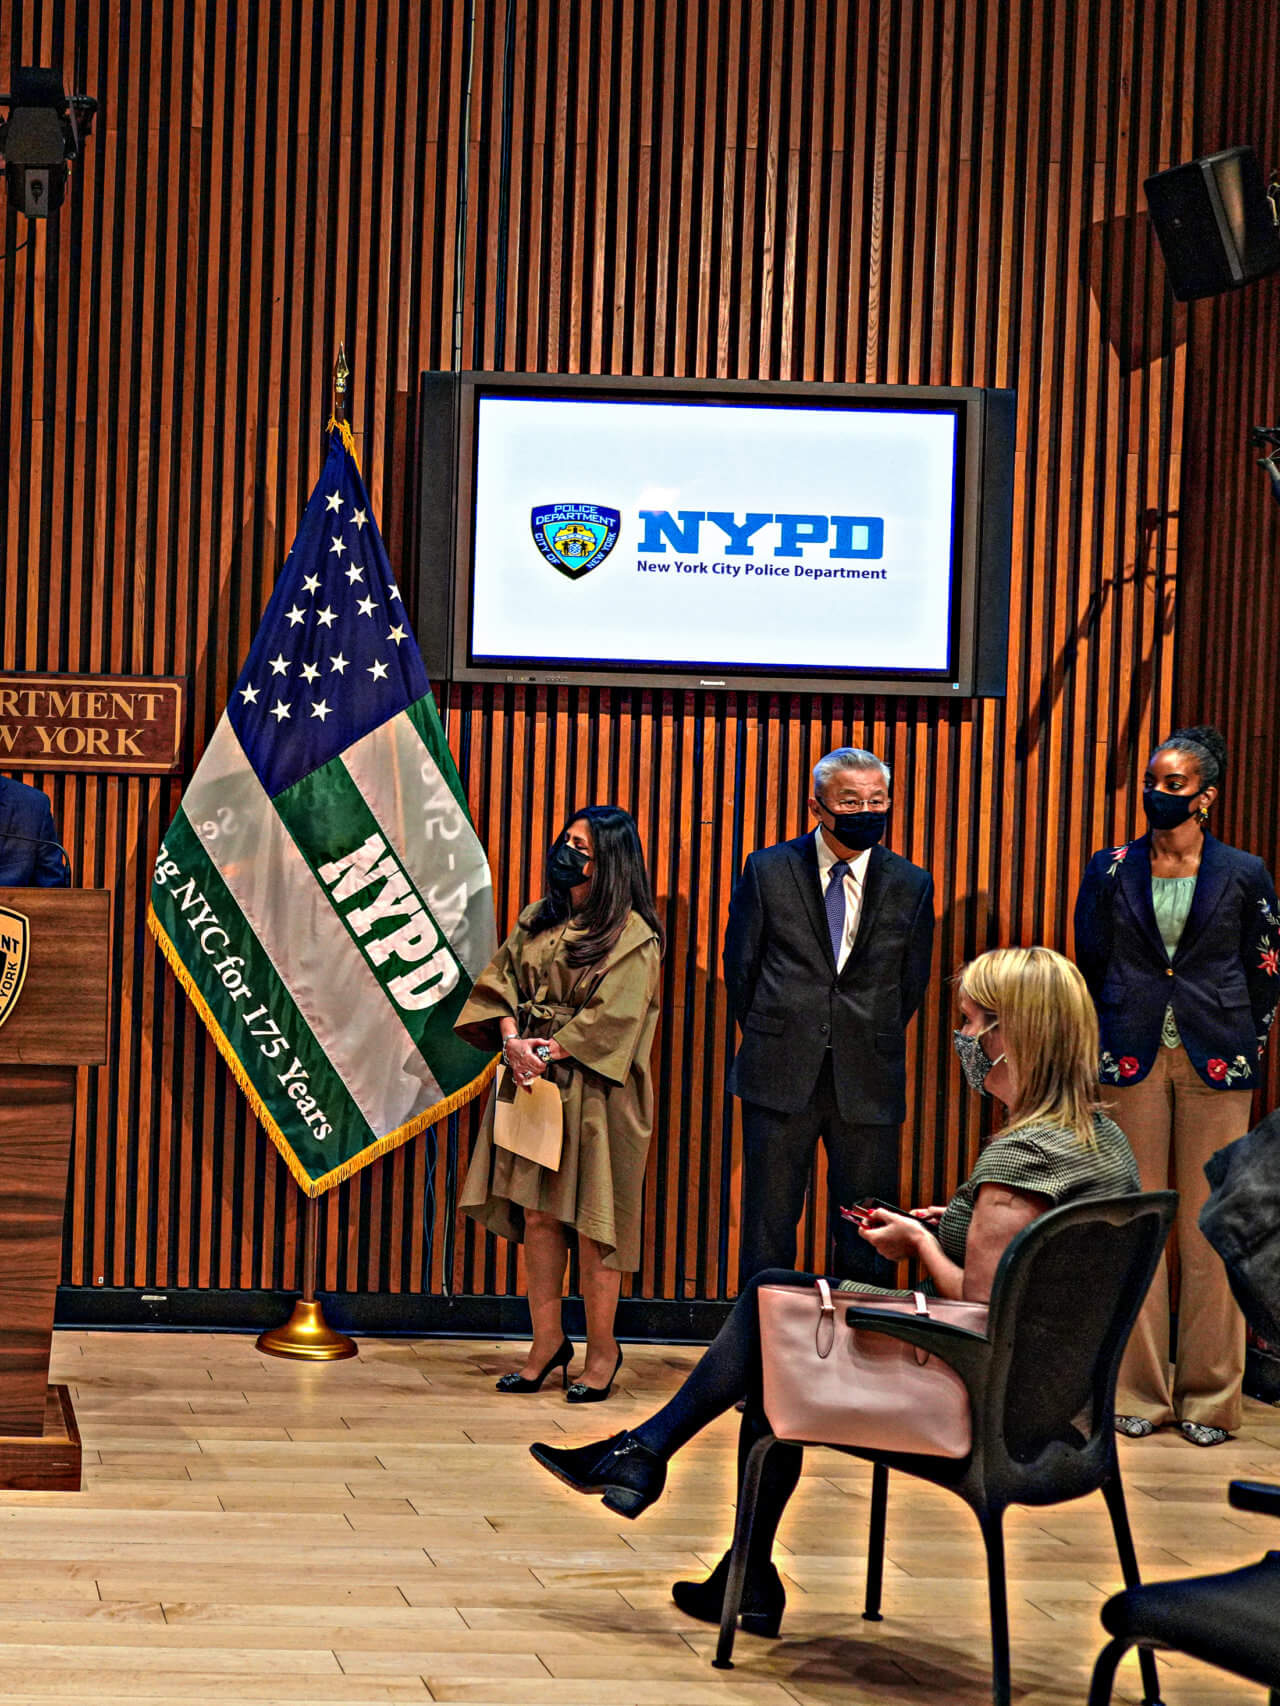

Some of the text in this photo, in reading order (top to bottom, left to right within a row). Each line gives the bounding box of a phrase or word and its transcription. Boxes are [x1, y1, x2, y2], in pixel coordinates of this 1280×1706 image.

[535, 512, 616, 527] DEPARTMENT
[554, 505, 598, 514] POLICE
[535, 533, 560, 564] CITY OF
[586, 532, 616, 568] NEW YORK
[637, 510, 884, 560] NYPD
[637, 560, 887, 580] New York City Police Department
[34, 726, 145, 756] YORK
[317, 832, 460, 1011] NYPD
[170, 877, 230, 955] NYC
[213, 955, 252, 1002] for
[242, 1003, 290, 1058] 175
[277, 1056, 333, 1141] Years
